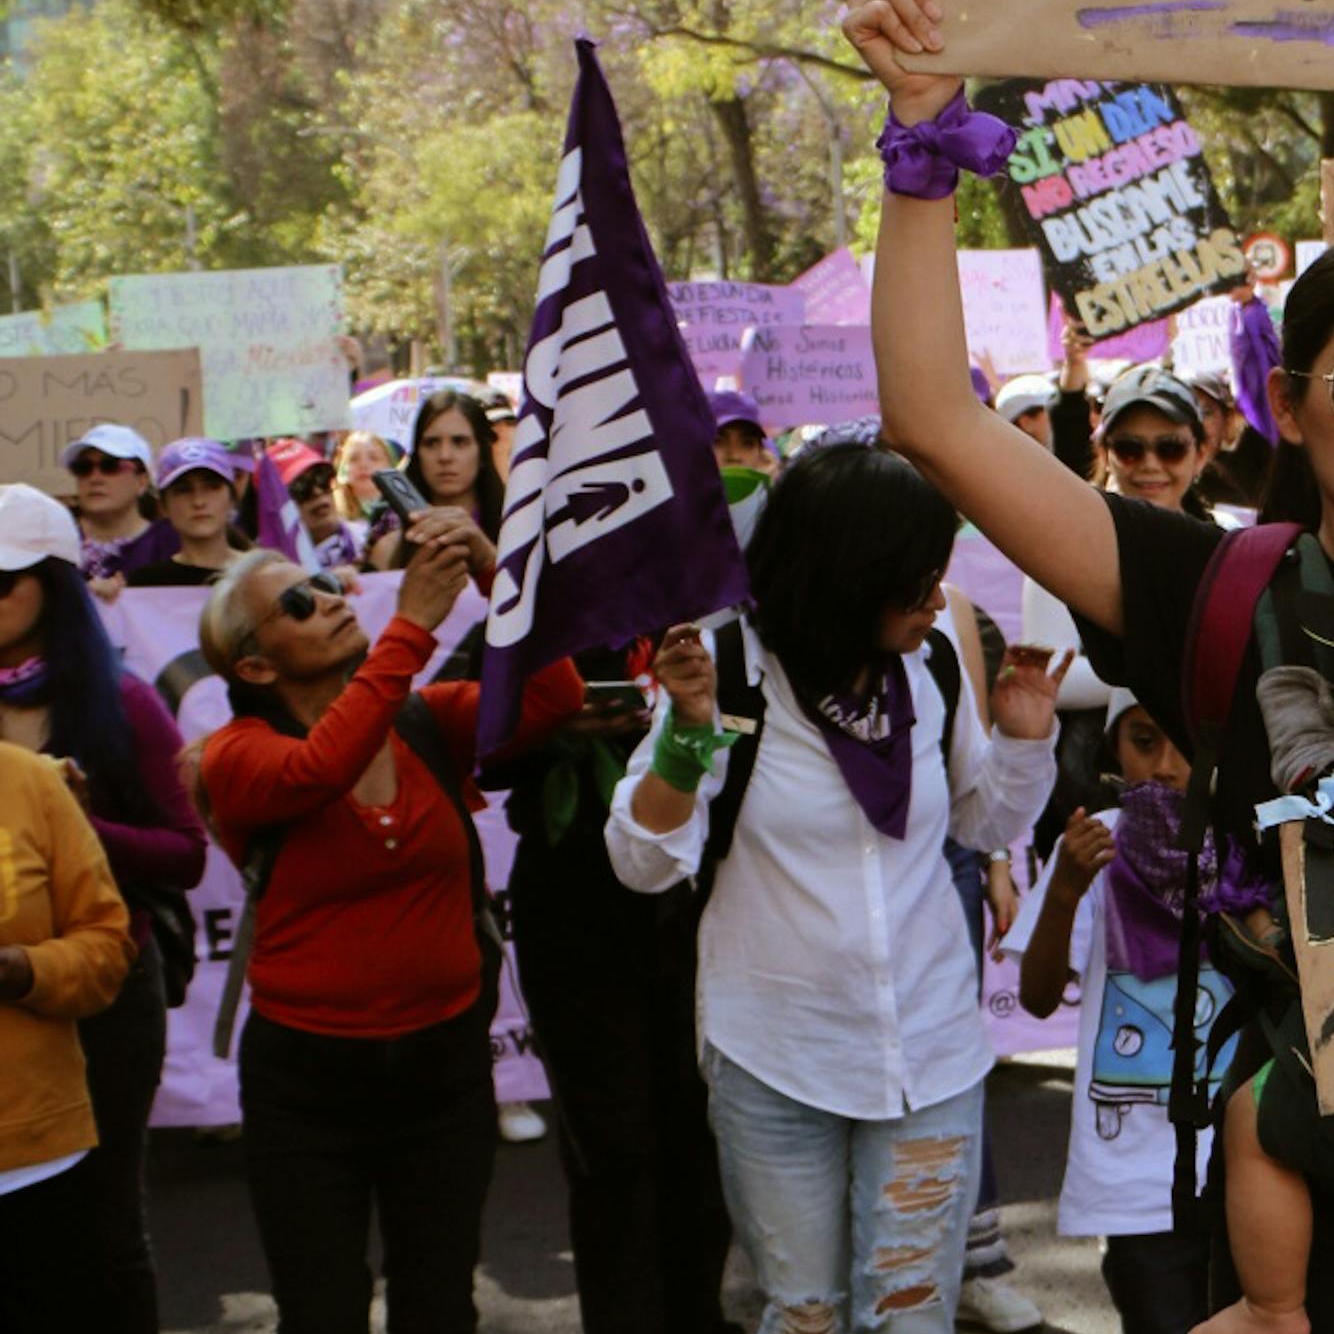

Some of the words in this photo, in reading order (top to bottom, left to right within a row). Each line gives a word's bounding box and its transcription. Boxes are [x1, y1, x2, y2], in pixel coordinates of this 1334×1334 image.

[1020, 175, 1073, 220] NO
[1066, 119, 1203, 200] REGRESO
[1074, 227, 1246, 338] ESTRELLAS
[1089, 238, 1140, 285] EN
[1138, 216, 1198, 265] LAS
